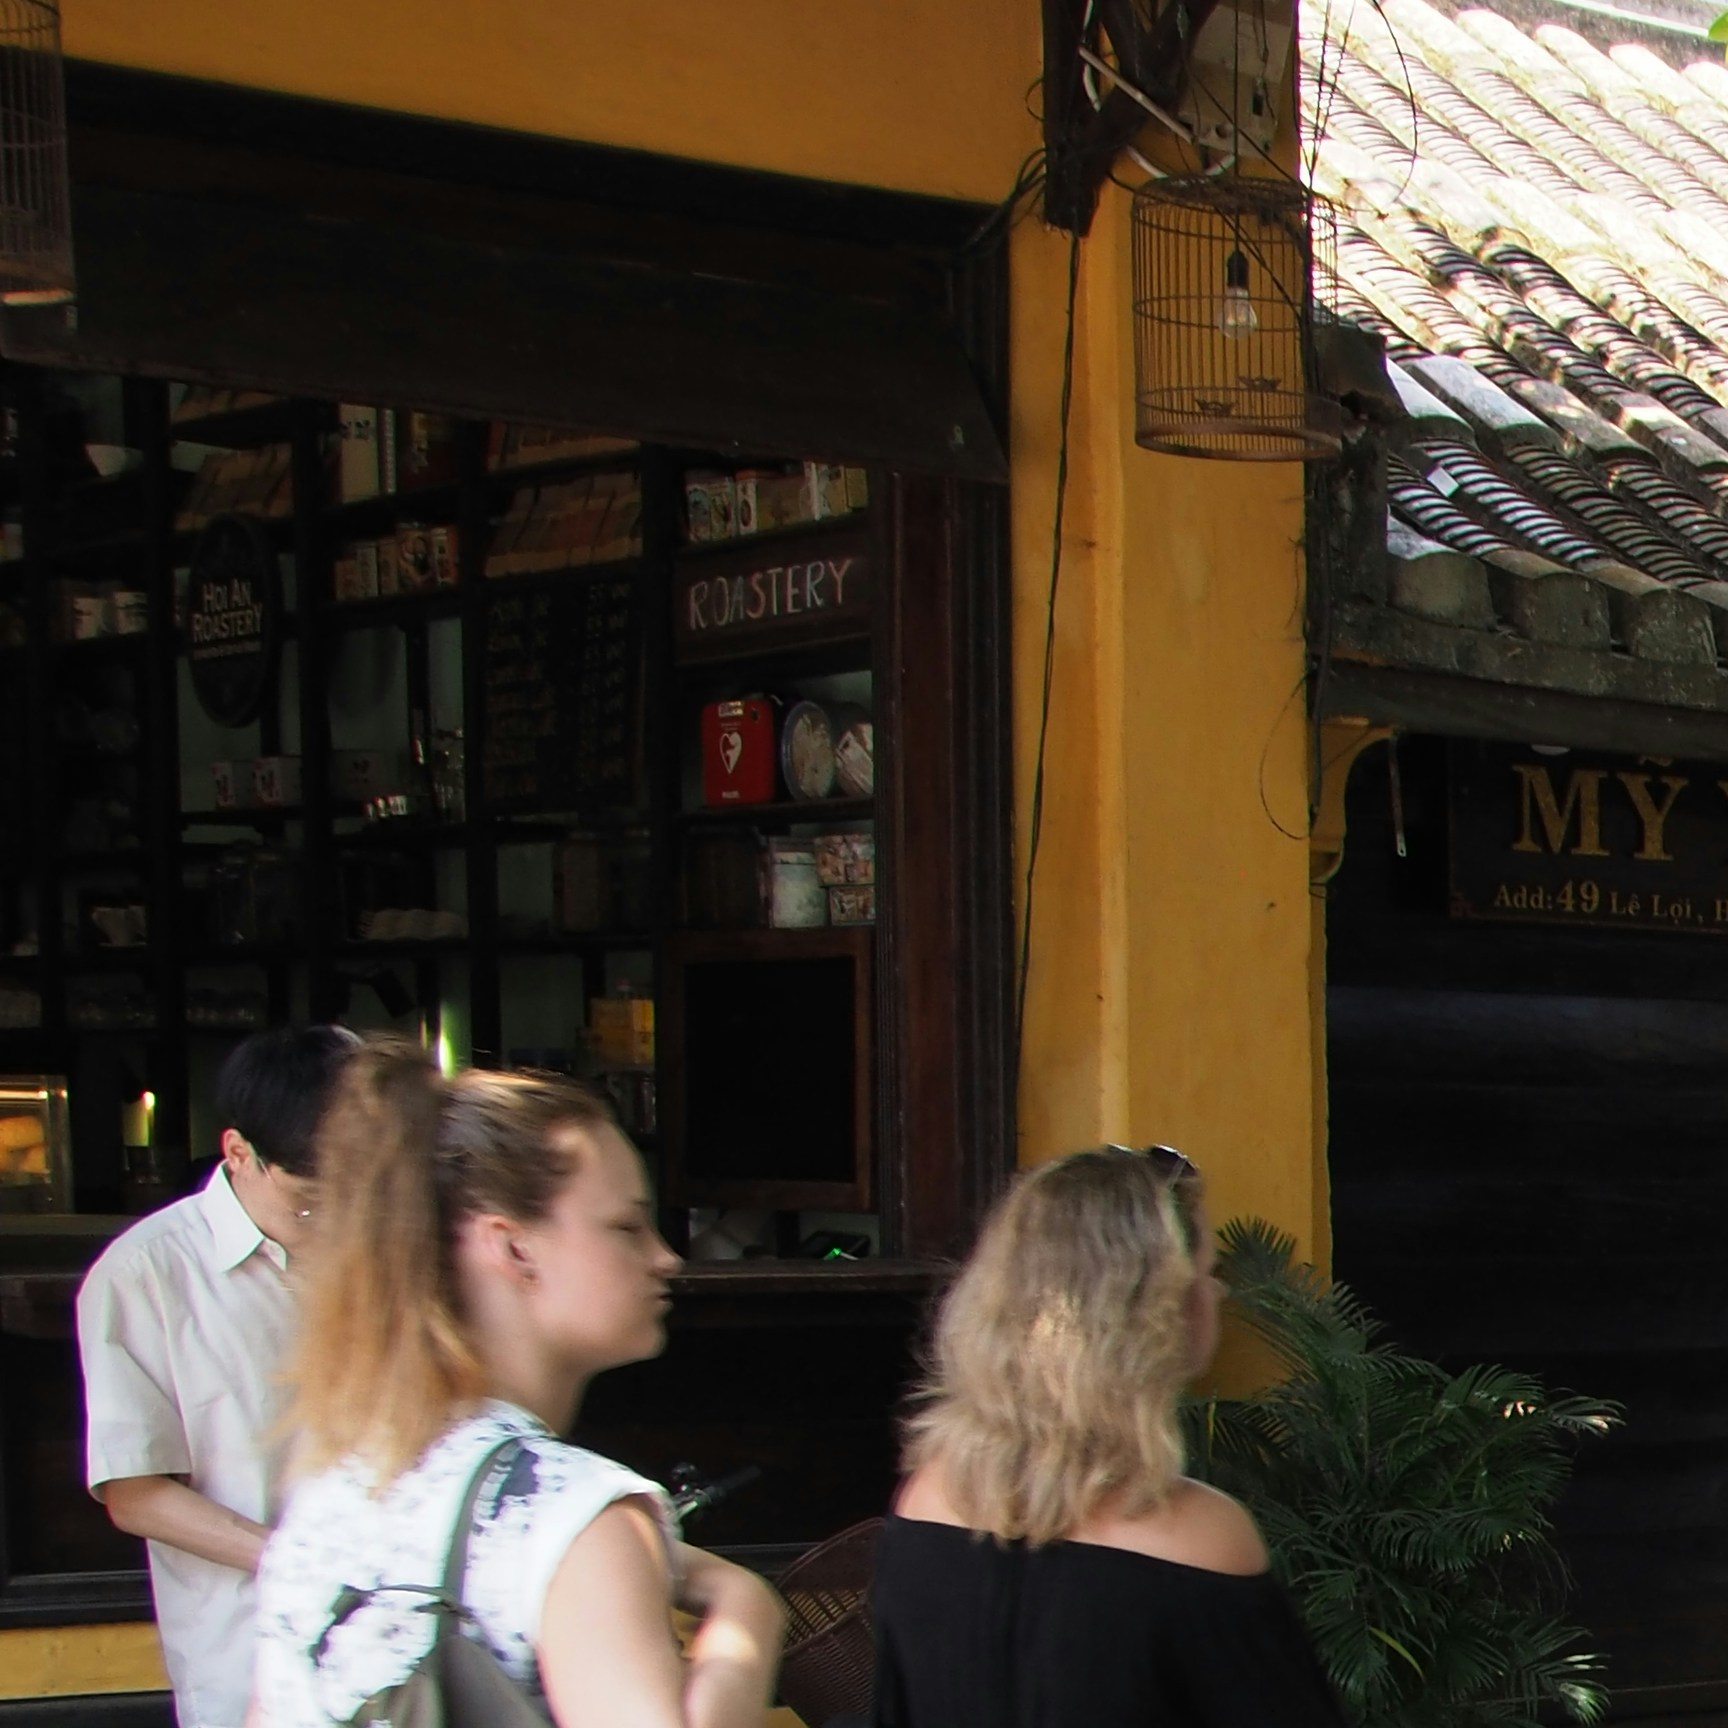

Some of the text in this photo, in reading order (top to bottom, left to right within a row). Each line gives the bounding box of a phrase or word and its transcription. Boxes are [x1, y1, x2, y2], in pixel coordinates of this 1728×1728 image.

[688, 557, 853, 632] ROASTERY
[192, 600, 263, 643] ROASTERY
[1610, 890, 1641, 915] Lê
